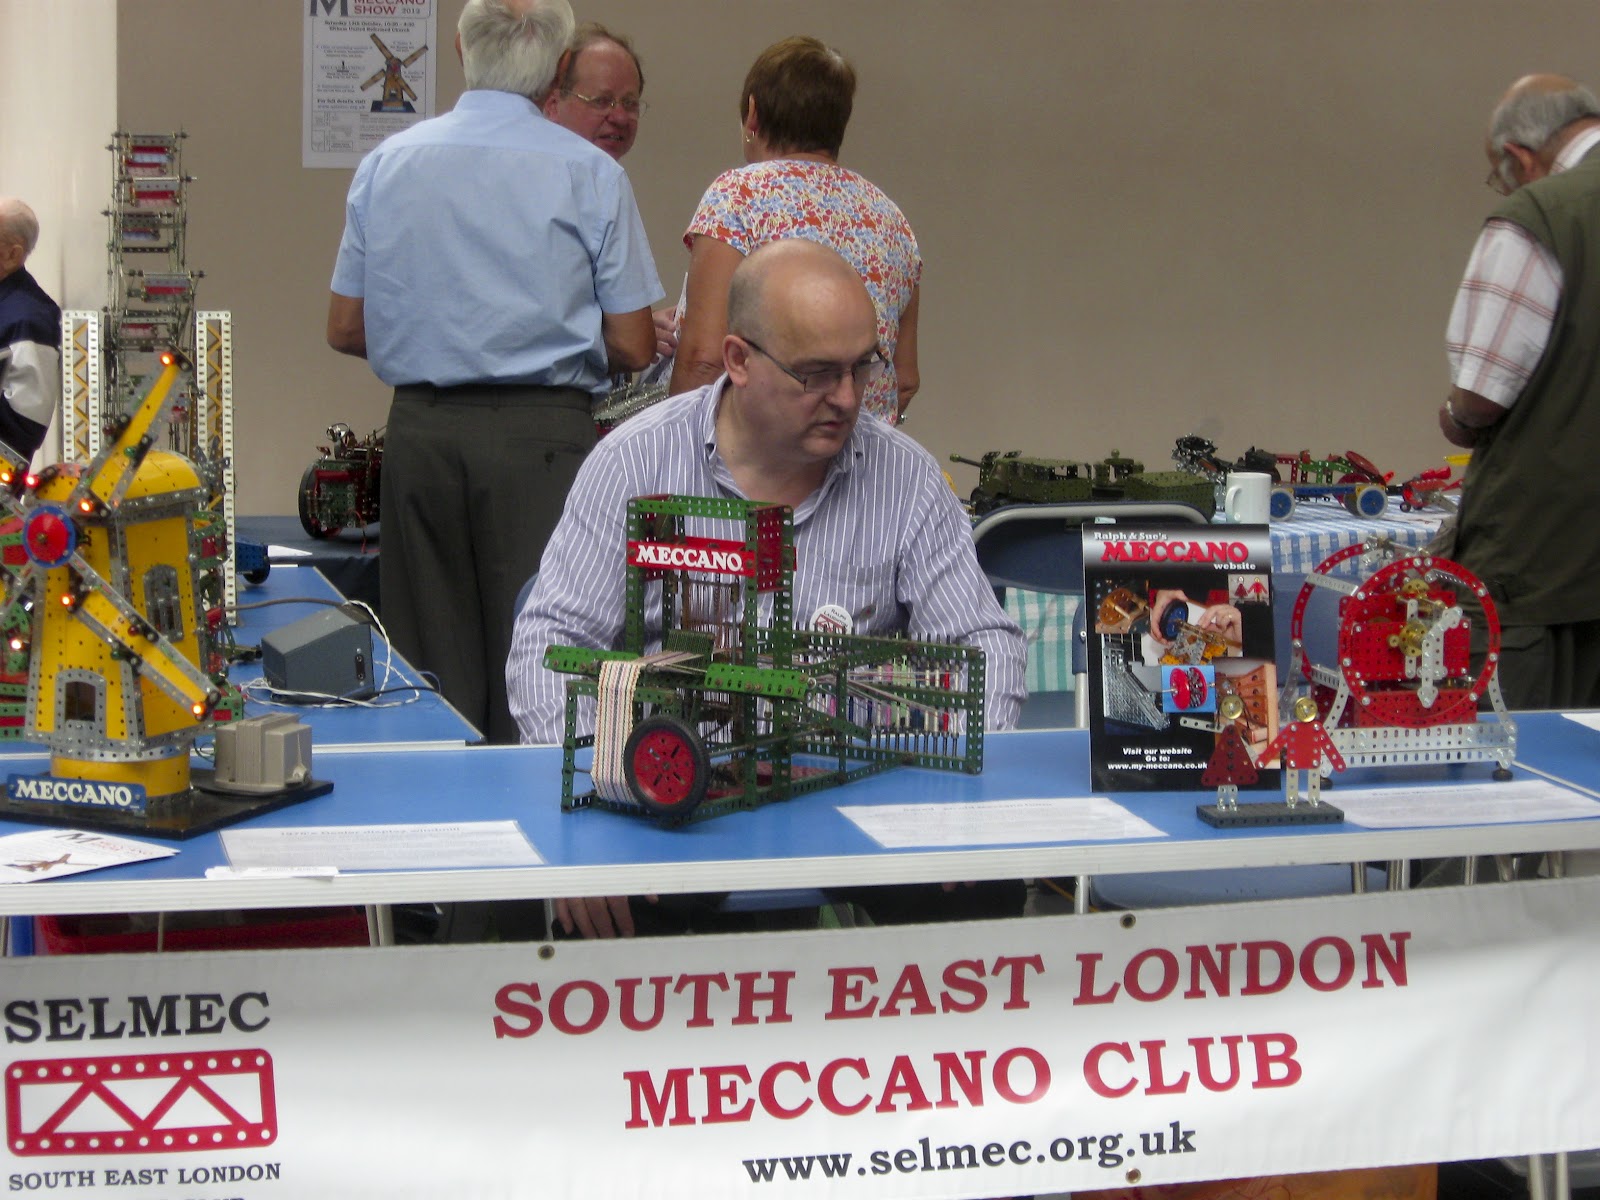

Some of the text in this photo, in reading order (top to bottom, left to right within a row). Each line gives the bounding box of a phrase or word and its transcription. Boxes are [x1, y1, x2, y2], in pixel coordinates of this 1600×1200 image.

[354, 5, 396, 15] SHOW
[1094, 532, 1127, 541] Ralph
[635, 544, 744, 573] MECCANO
[1101, 541, 1249, 563] MECCANO
[1213, 562, 1256, 570] website
[1122, 747, 1142, 755] Visit
[1159, 747, 1192, 755] website
[1107, 762, 1208, 770] www.my-meccano.co.uk
[15, 779, 132, 806] MECCANO
[493, 931, 1412, 1039] SOUTH EAST LONDON
[4, 991, 271, 1044] SELMEC
[623, 1032, 1303, 1129] MECCANO CLUB
[742, 1121, 1198, 1169] www.selmec.org.uk
[8, 1163, 282, 1191] SOUTH EAST LONDON
